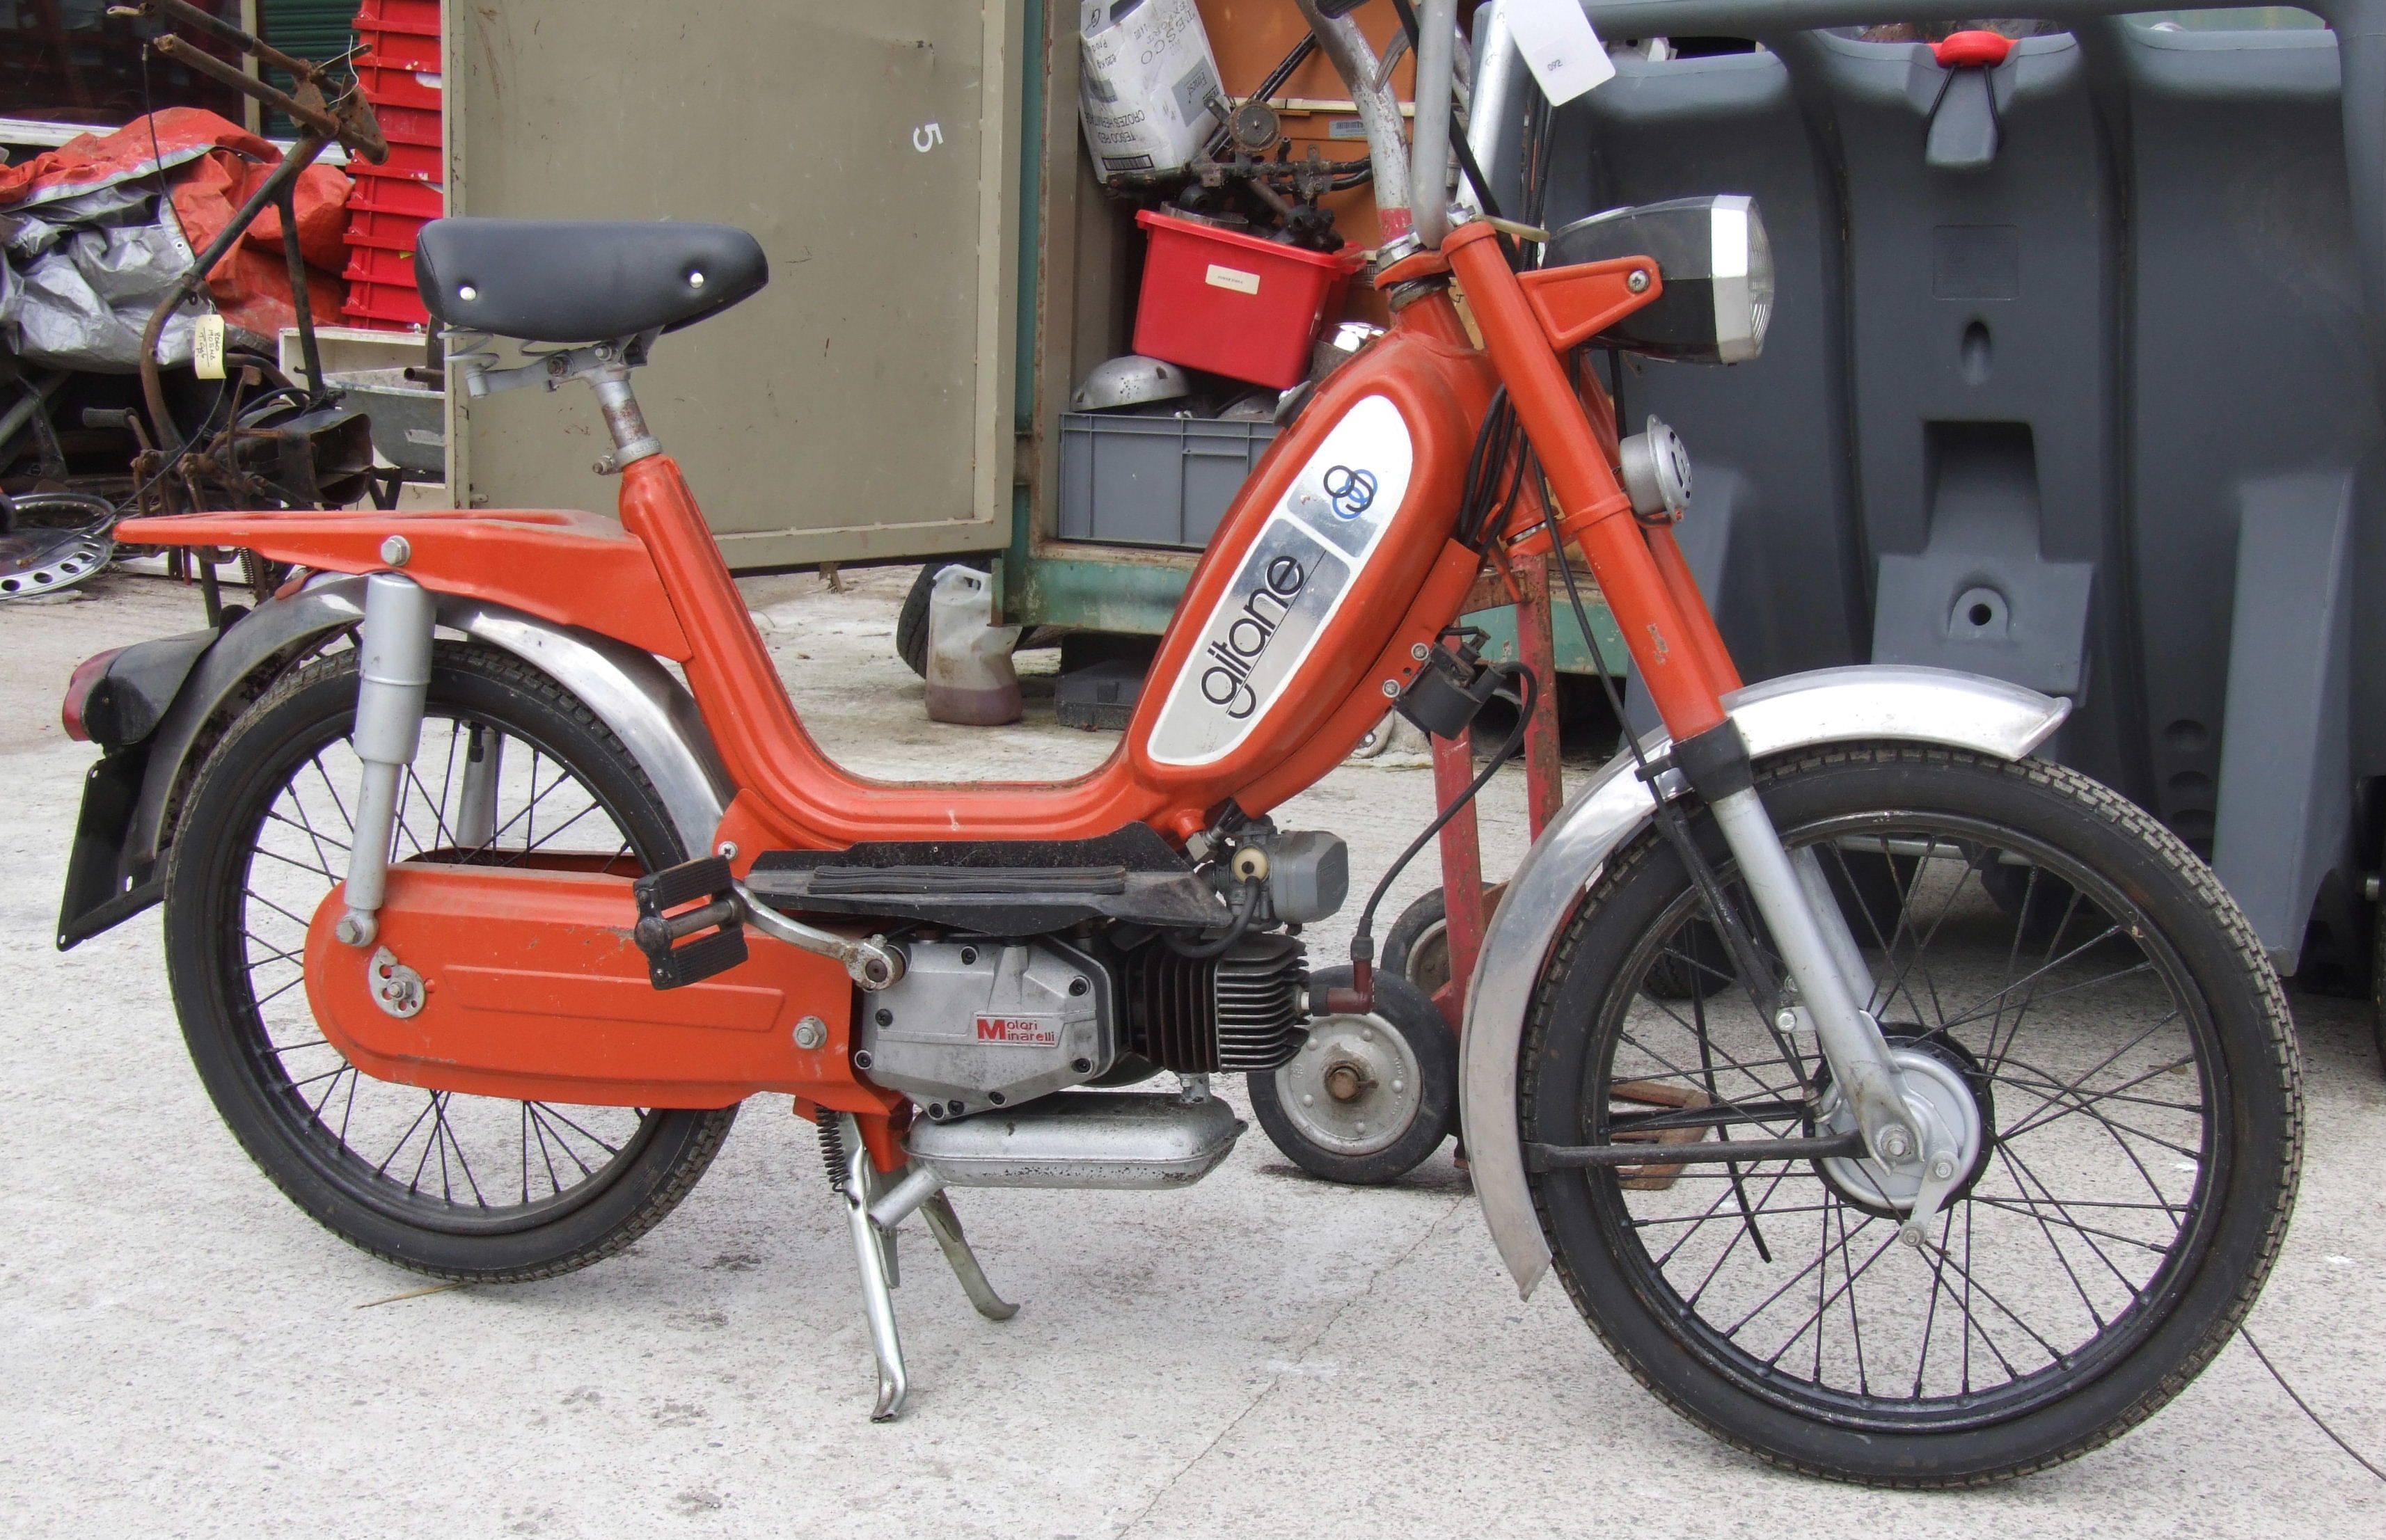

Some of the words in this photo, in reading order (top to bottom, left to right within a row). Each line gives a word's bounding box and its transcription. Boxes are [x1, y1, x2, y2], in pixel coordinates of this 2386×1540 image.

[1141, 9, 1195, 65] TESCO
[1114, 110, 1145, 128] CROZES
[913, 123, 943, 152] 5
[1111, 130, 1136, 143] TESCO
[1201, 556, 1304, 719] gitane
